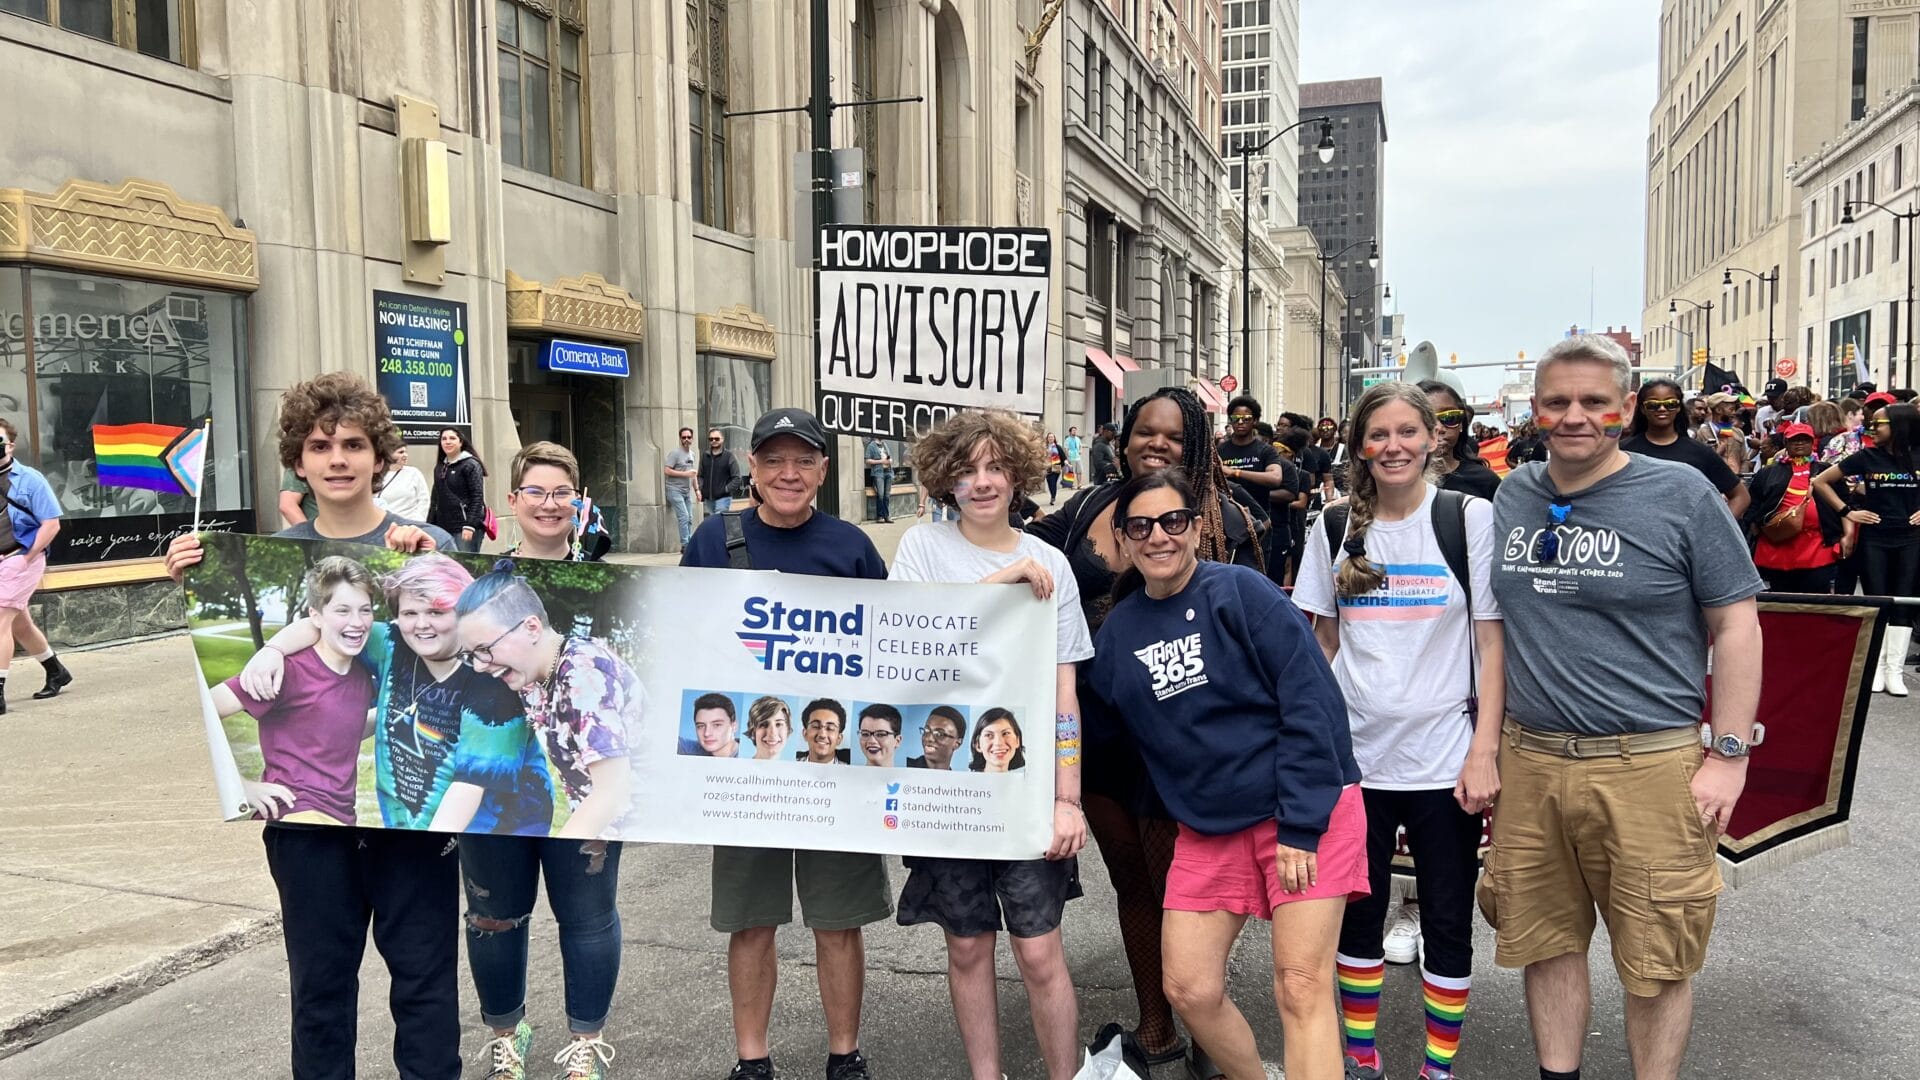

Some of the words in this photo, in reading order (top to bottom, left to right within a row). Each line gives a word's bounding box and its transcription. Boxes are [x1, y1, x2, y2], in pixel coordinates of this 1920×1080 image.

[820, 229, 1048, 273] HOMOPHOBE
[379, 300, 387, 308] An
[388, 302, 401, 310] icon
[402, 303, 408, 311] in
[379, 311, 407, 326] NOW
[408, 314, 451, 332] LEASING!
[387, 336, 404, 346] MATT
[406, 337, 443, 349] SCHIFFMAN
[828, 282, 1040, 395] ADVISORY
[391, 347, 401, 356] OR
[403, 347, 419, 358] MIKE
[420, 349, 440, 360] GUNN
[601, 352, 623, 368] Bank
[35, 361, 128, 374] PARK
[381, 358, 452, 378] 248.358.0100
[821, 394, 907, 438] QUEER
[69, 533, 103, 548] raise
[101, 533, 143, 560] your
[1556, 525, 1621, 566] YOU
[1395, 578, 1435, 586] ADVOCATE
[1395, 588, 1436, 596] CELEBRATE
[742, 597, 864, 636] Stand
[879, 612, 979, 630] ADVOCATE
[804, 636, 859, 649] WITH
[878, 638, 979, 656] CELEBRATE
[1134, 632, 1201, 668] THRIVE
[737, 633, 864, 677] Trans
[877, 665, 961, 682] EDUCATE
[1149, 649, 1204, 690] 365
[1154, 683, 1175, 698] Stand
[1186, 674, 1208, 685] Trans
[706, 774, 837, 789] www.callhimhunter.com
[703, 790, 832, 808] roz@standwithtrans.org
[903, 785, 992, 798] @standwithtrans
[702, 808, 836, 826] www.standwithtrans.org
[902, 801, 982, 815] standwithtrans
[901, 818, 1005, 833] @standwithtransmi
